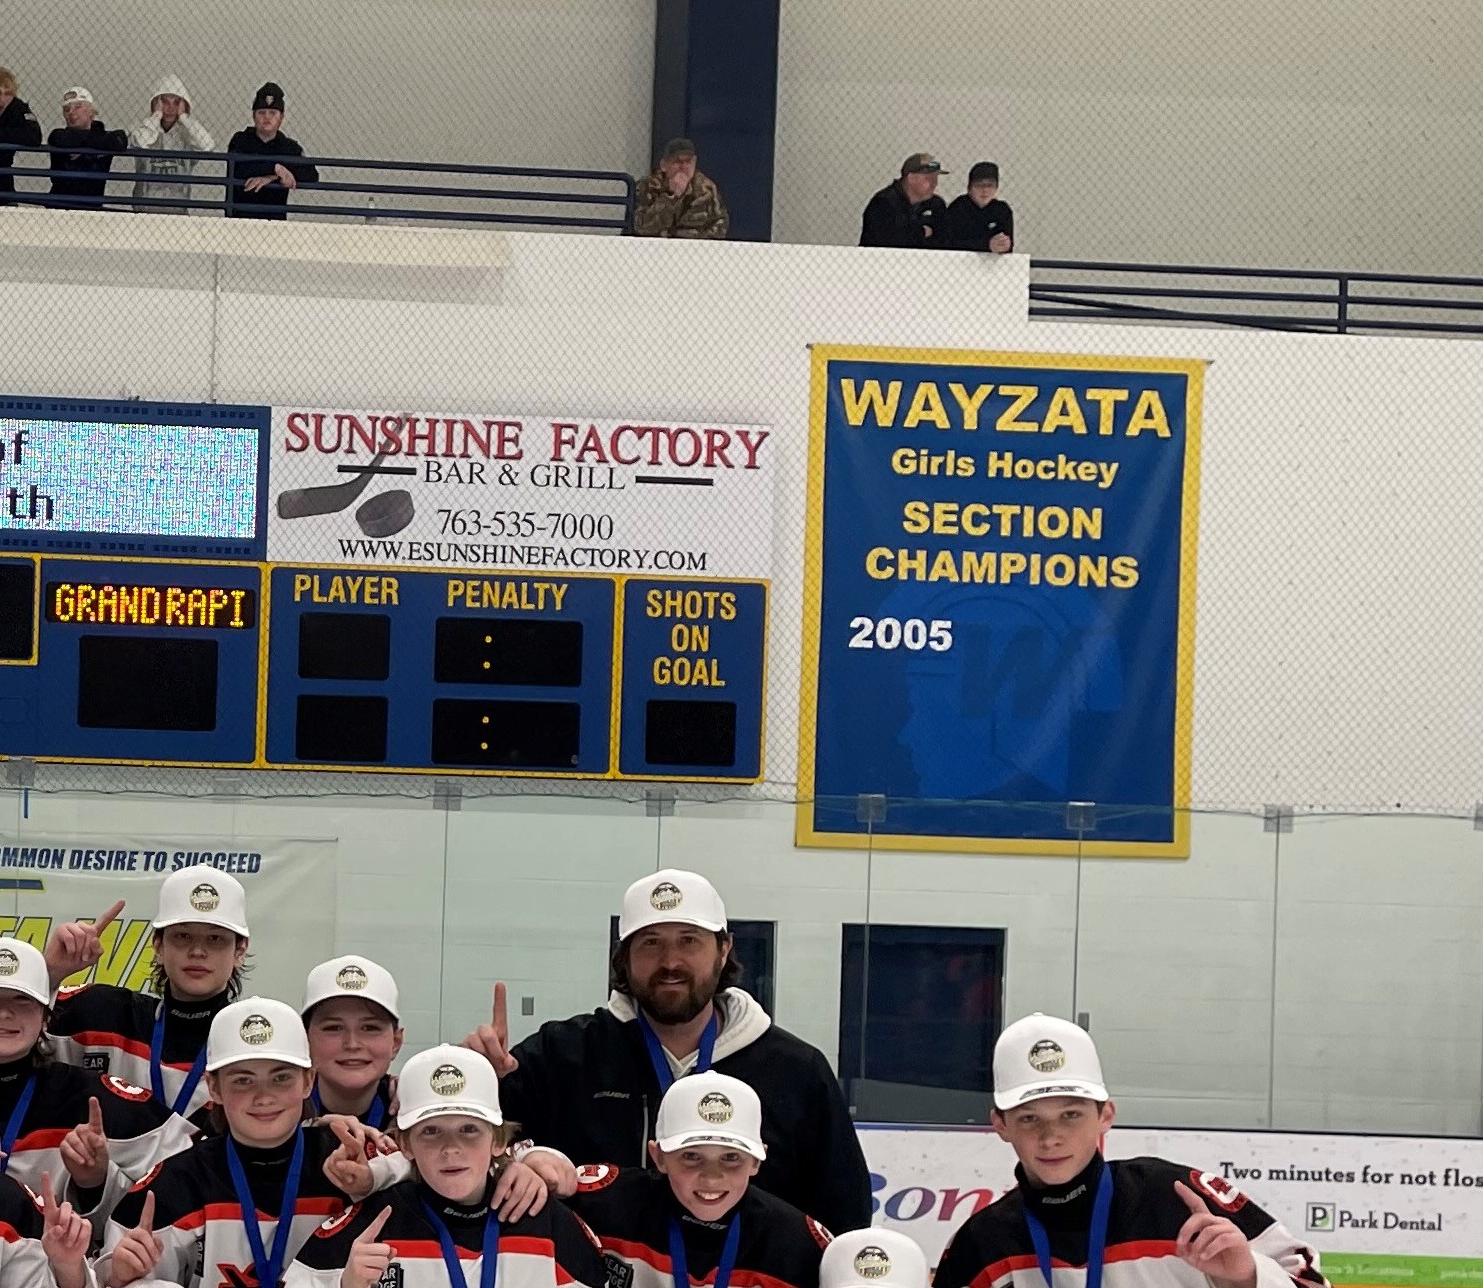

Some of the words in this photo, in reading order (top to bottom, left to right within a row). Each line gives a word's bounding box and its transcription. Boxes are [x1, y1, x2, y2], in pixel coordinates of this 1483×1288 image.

[840, 378, 1172, 438] WAYZATA
[284, 412, 523, 461] SUNSHINE
[551, 422, 770, 470] FACTORY
[424, 460, 485, 485] BAR
[498, 464, 519, 486] &
[530, 465, 625, 491] GRILL
[891, 448, 976, 477] Girls
[987, 451, 1119, 489] Hockey
[437, 509, 614, 540] 763-535-7000
[902, 501, 1103, 539] SECTION
[338, 539, 707, 571] WWW.ESUNSHINEFACTORY.COM
[865, 547, 1139, 588] CHAMPIONS
[294, 574, 399, 606] PLAYER
[447, 580, 568, 611] PENALTY
[646, 590, 737, 620] SHOTS
[55, 584, 247, 628] GRANDRAPI
[671, 624, 709, 652] ON
[849, 616, 953, 651] 2005
[653, 656, 726, 686] GOAL
[69, 848, 137, 871] DESIRE
[143, 851, 166, 872] TO
[83, 1057, 104, 1069] EAR
[1220, 1162, 1261, 1181] Two
[1268, 1164, 1355, 1183] minutes
[1362, 1165, 1393, 1184] for
[1400, 1170, 1437, 1186] not
[1339, 1211, 1378, 1229] Park
[1383, 1212, 1442, 1231] Dental
